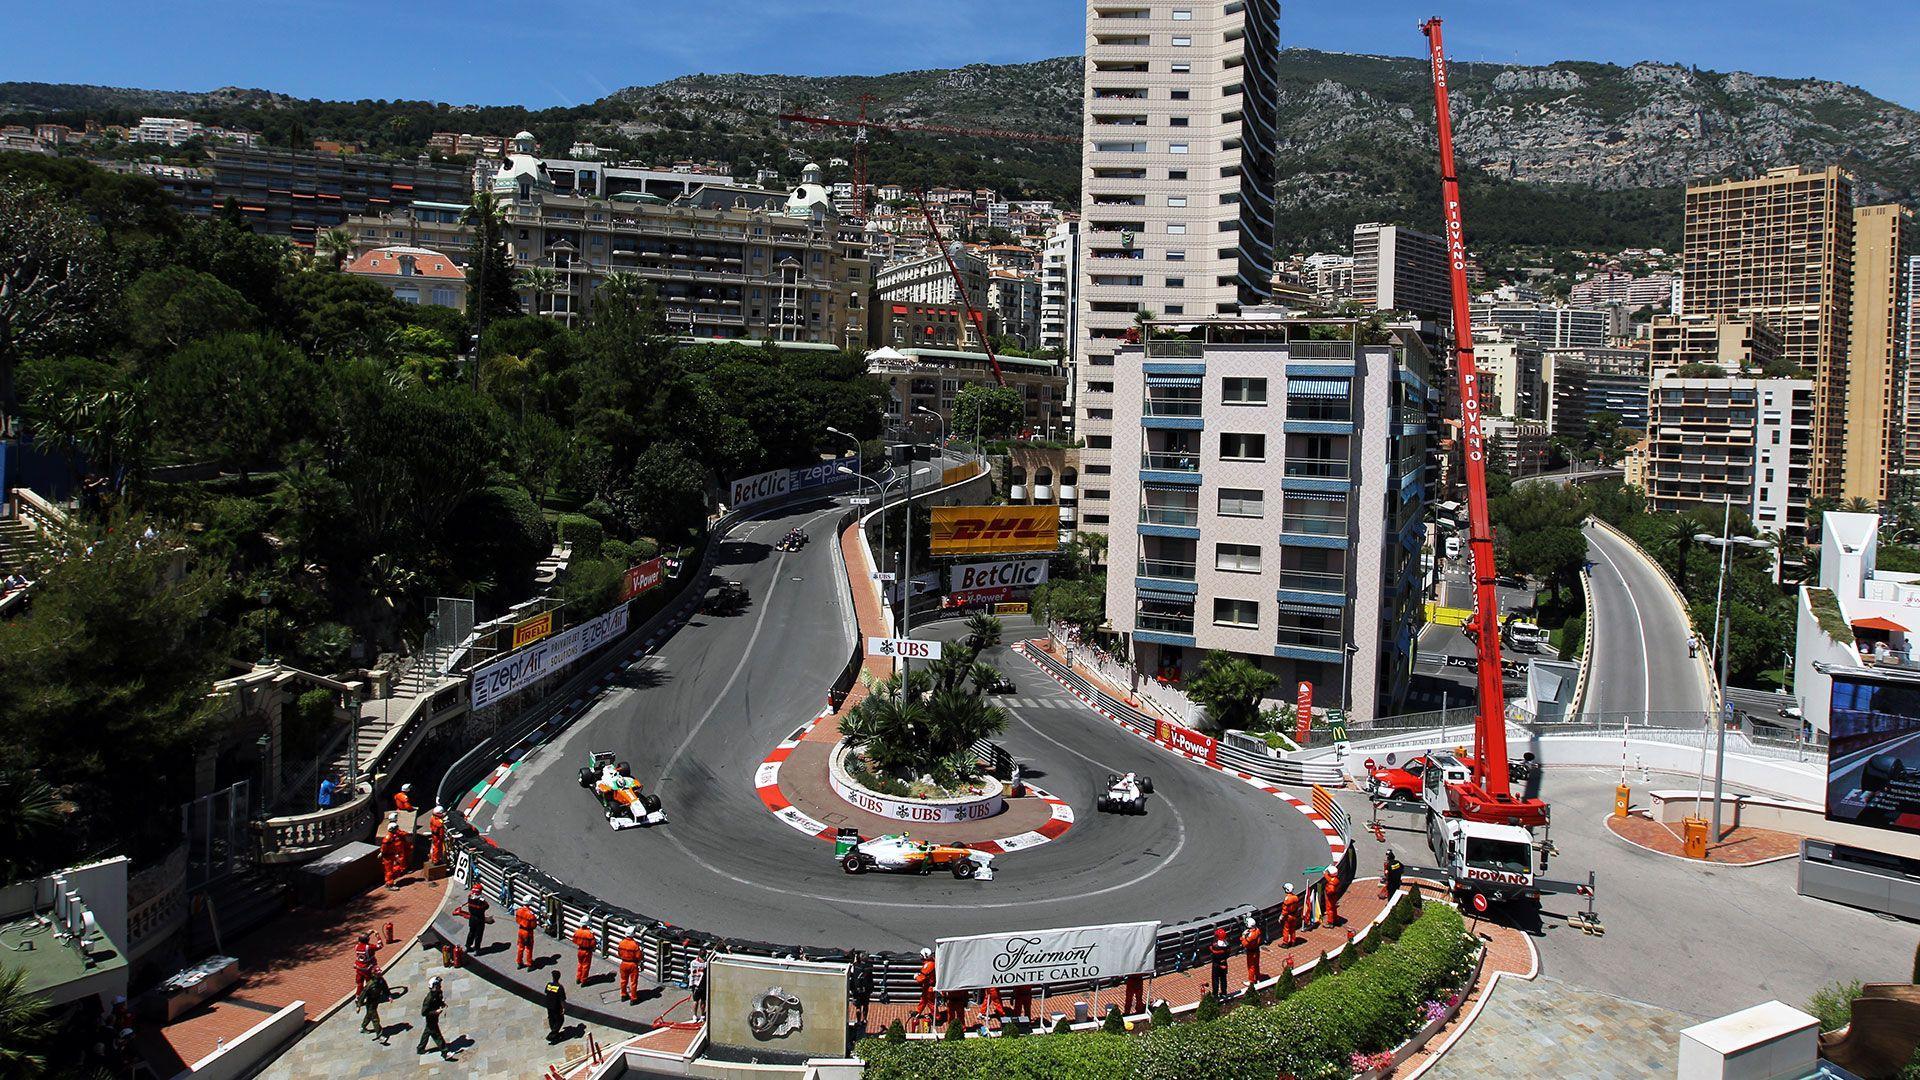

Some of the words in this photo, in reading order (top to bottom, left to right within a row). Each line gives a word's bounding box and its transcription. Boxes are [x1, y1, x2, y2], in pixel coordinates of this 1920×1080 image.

[1436, 46, 1445, 87] PIOVANO
[1449, 201, 1464, 270] PIOVANO
[1465, 374, 1482, 461] PIOVANO
[734, 471, 786, 506] BetClic
[951, 518, 1040, 540] DHL
[632, 571, 659, 591] V-Power
[961, 561, 1038, 589] BetClic
[967, 593, 1005, 604] V-Power
[516, 615, 549, 644] PIRELLI
[551, 645, 578, 667] SOLUTIONS
[896, 641, 929, 657] UBS
[1171, 731, 1209, 758] V-Power
[859, 795, 883, 813] UBS
[912, 807, 942, 821] UBS
[968, 802, 990, 819] UBS
[456, 856, 468, 880] SC
[1468, 869, 1529, 885] PIOVANO
[992, 937, 1100, 972] Fairmont
[991, 971, 1044, 985] MONTE
[1050, 965, 1099, 980] CARLO
